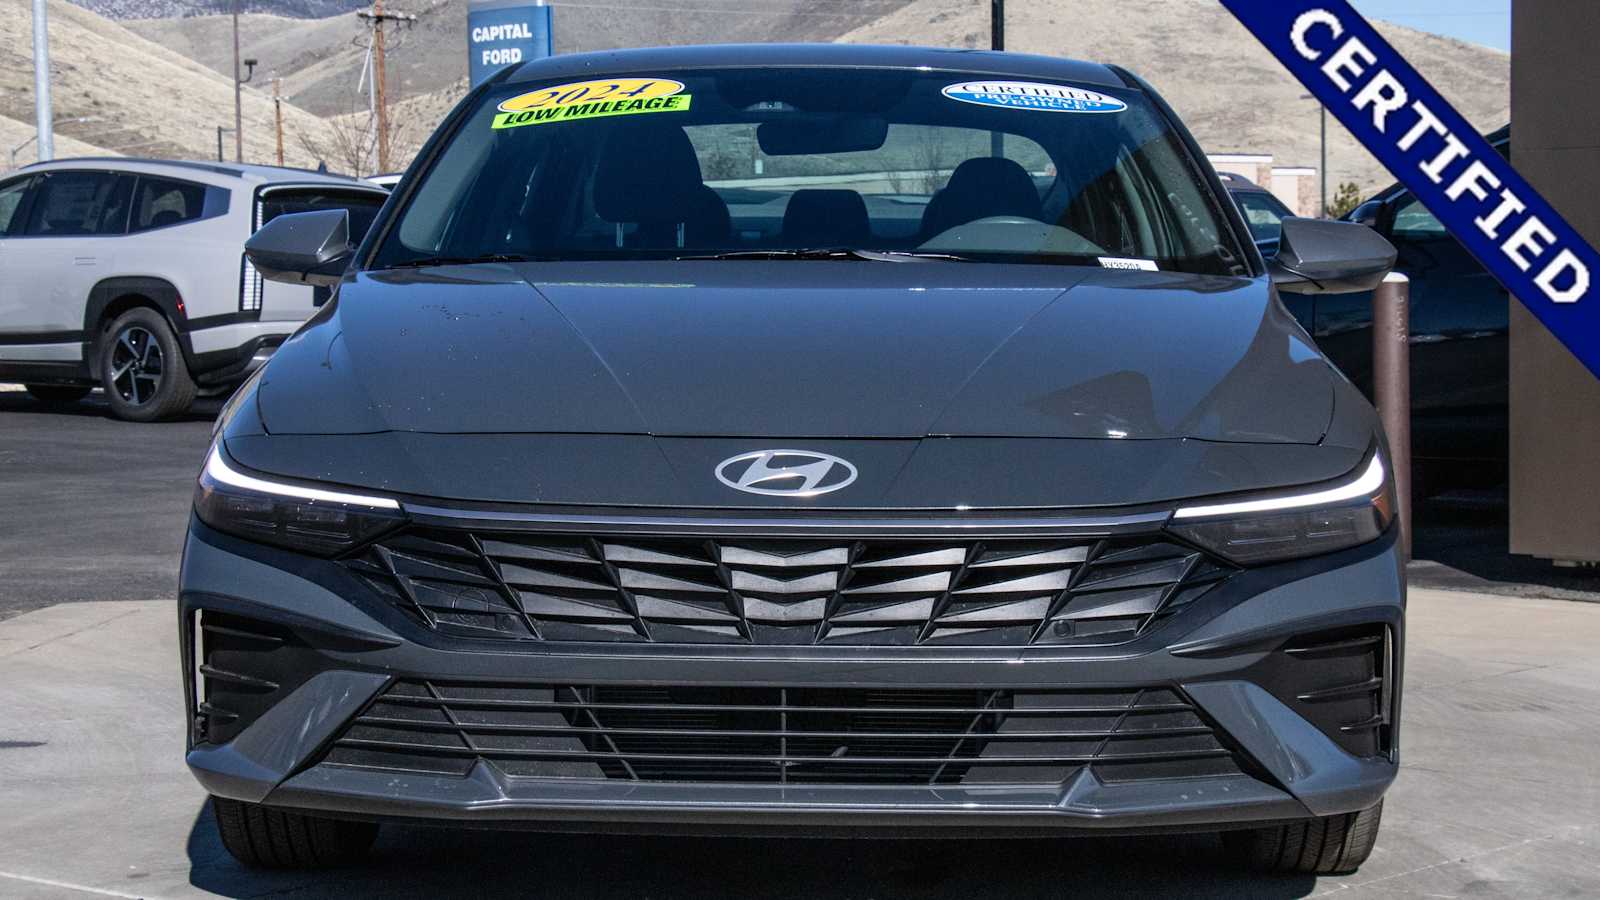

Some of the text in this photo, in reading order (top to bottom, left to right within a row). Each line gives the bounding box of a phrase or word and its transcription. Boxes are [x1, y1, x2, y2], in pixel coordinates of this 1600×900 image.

[472, 23, 532, 43] CAPITAL
[482, 48, 522, 65] FORD
[526, 82, 656, 108] 2024
[962, 84, 1103, 101] CERTIFIED
[503, 96, 682, 125] LOW MILEAGE
